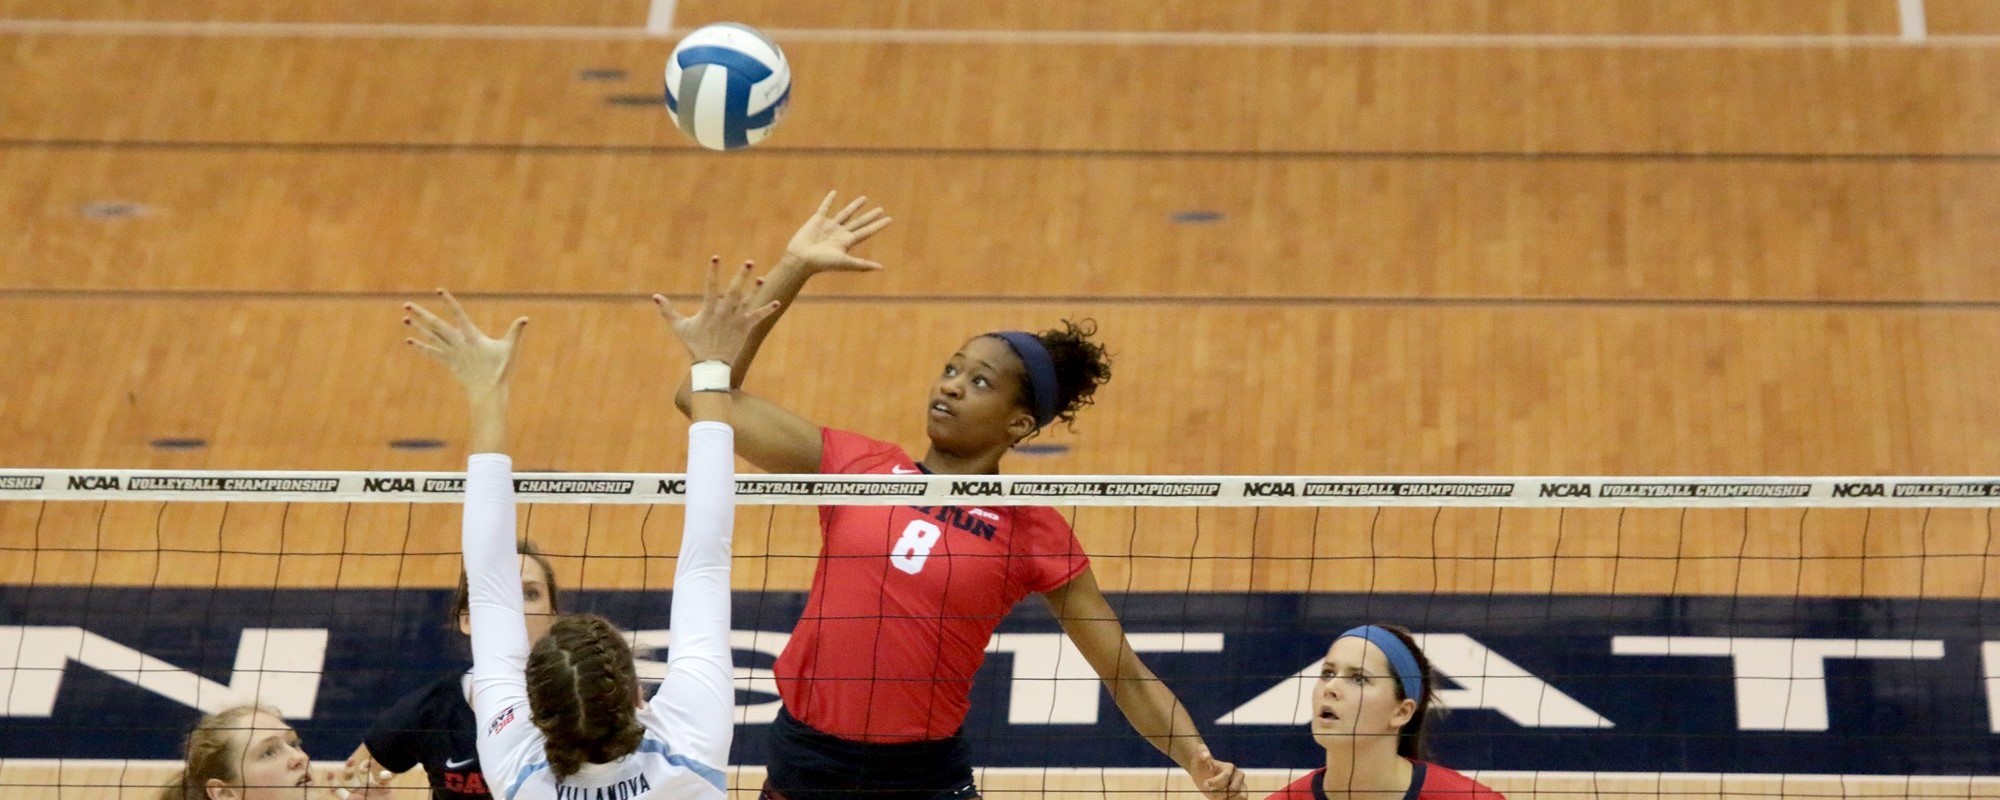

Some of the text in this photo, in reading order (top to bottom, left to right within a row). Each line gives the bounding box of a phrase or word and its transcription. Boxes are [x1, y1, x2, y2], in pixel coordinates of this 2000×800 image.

[67, 476, 120, 490] NCAA
[130, 477, 220, 490] VOLLEYBALL
[223, 478, 338, 491] CHAMPIONSHIP
[363, 478, 415, 492] NCAA
[426, 480, 466, 492] VOLL
[518, 480, 632, 493] CHAMPIONSHIP
[657, 480, 687, 494] NC
[735, 482, 810, 495] LLEYBALL
[812, 482, 926, 496] CHAMPIONSHIP
[950, 482, 1001, 496] NCAA
[1012, 483, 1102, 496] VOLLEYBALL
[1105, 484, 1219, 496] CHAMPIONSHIP
[1243, 483, 1295, 497] NCAA
[1305, 484, 1395, 496] VOLLEYBALL
[1398, 484, 1513, 497] CHAMPIONSHIP
[1539, 483, 1591, 498] NCAA
[1602, 484, 1692, 497] VOLLEYBALL
[1695, 485, 1809, 497] CHAMPIONSHIP
[1832, 484, 1884, 497] NCAA
[1895, 484, 1986, 497] VOLLEYBALL
[889, 519, 941, 575] 8
[495, 713, 515, 735] BIG
[555, 773, 651, 800] VILLANOVA
